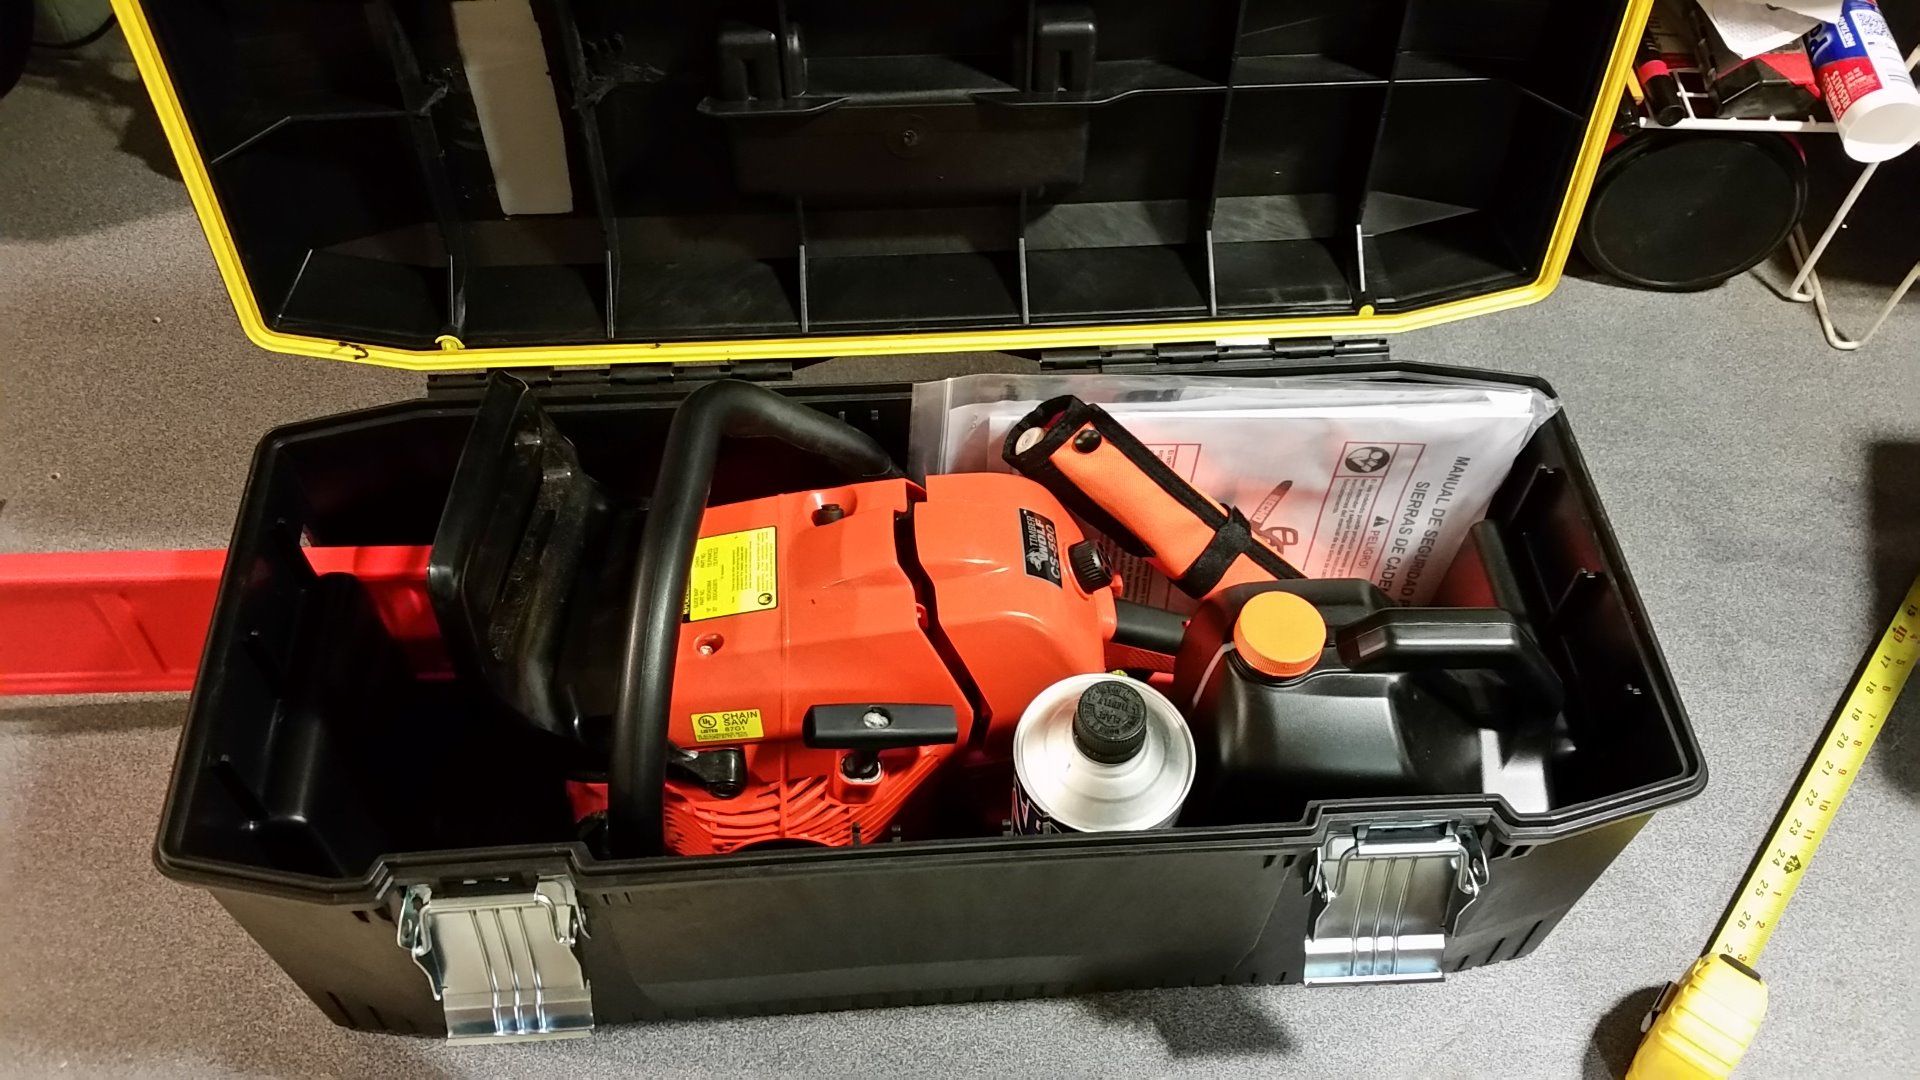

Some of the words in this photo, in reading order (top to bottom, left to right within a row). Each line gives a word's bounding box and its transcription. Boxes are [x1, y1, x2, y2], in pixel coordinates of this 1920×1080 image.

[1830, 70, 1852, 106] RESULTS
[1435, 456, 1470, 505] MANUAL
[1398, 481, 1430, 535] SIERRAS
[1428, 508, 1445, 527] DE
[1026, 515, 1037, 547] TIMBER
[1035, 518, 1048, 560] WOLF
[1046, 524, 1060, 578] CS-590
[1391, 536, 1408, 555] DE
[1402, 530, 1436, 598] SEGURIDAD
[1880, 654, 1891, 668] 17
[1866, 681, 1876, 694] 18
[722, 711, 758, 720] CHAIN
[1852, 708, 1862, 722] 19
[1836, 732, 1848, 748] 20
[1822, 760, 1834, 776] 21
[1806, 788, 1818, 807] 22
[1818, 800, 1831, 812] 10
[1789, 818, 1802, 836] 23
[1804, 830, 1816, 840] 11
[1772, 848, 1786, 866] 24
[1756, 880, 1768, 898] 25
[1738, 910, 1752, 930] 26
